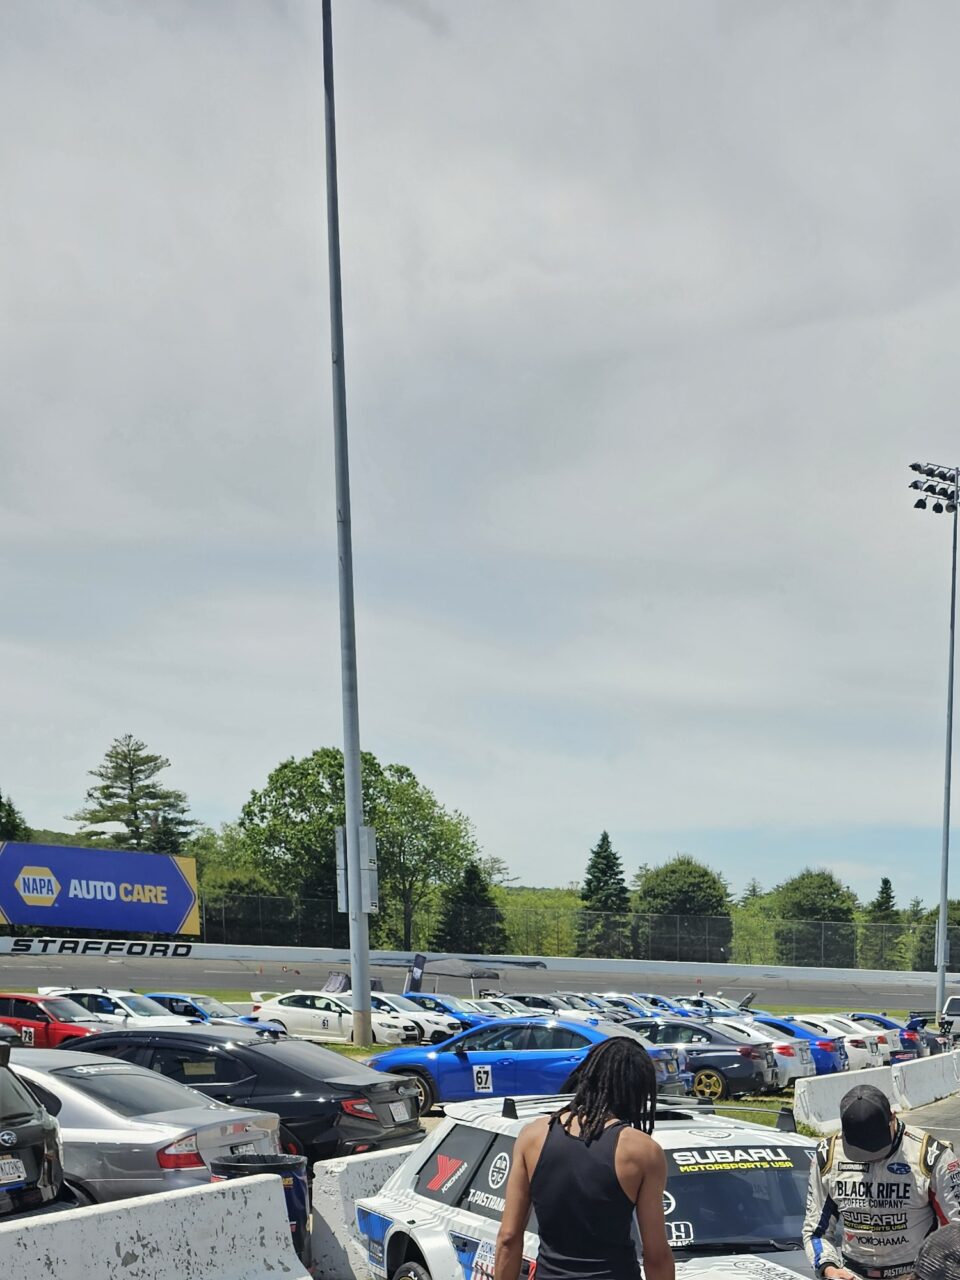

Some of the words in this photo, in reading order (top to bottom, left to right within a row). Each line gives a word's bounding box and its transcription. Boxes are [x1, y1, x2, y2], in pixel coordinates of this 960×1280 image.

[22, 877, 54, 895] NAPA
[69, 879, 116, 900] AUTO
[119, 883, 168, 904] CARE
[11, 938, 192, 957] STAFFORD
[24, 1031, 33, 1041] 78
[475, 1070, 490, 1086] 67
[672, 1148, 790, 1165] SUBARU
[679, 1162, 770, 1172] MOTORSPORTS
[837, 1181, 873, 1199] BLACK
[877, 1183, 911, 1200] RIFLE
[843, 1198, 867, 1208] COFFEE
[868, 1199, 904, 1209] COMPANY
[842, 1211, 908, 1226] SUBARU
[856, 1236, 909, 1246] YOKOHAMA
